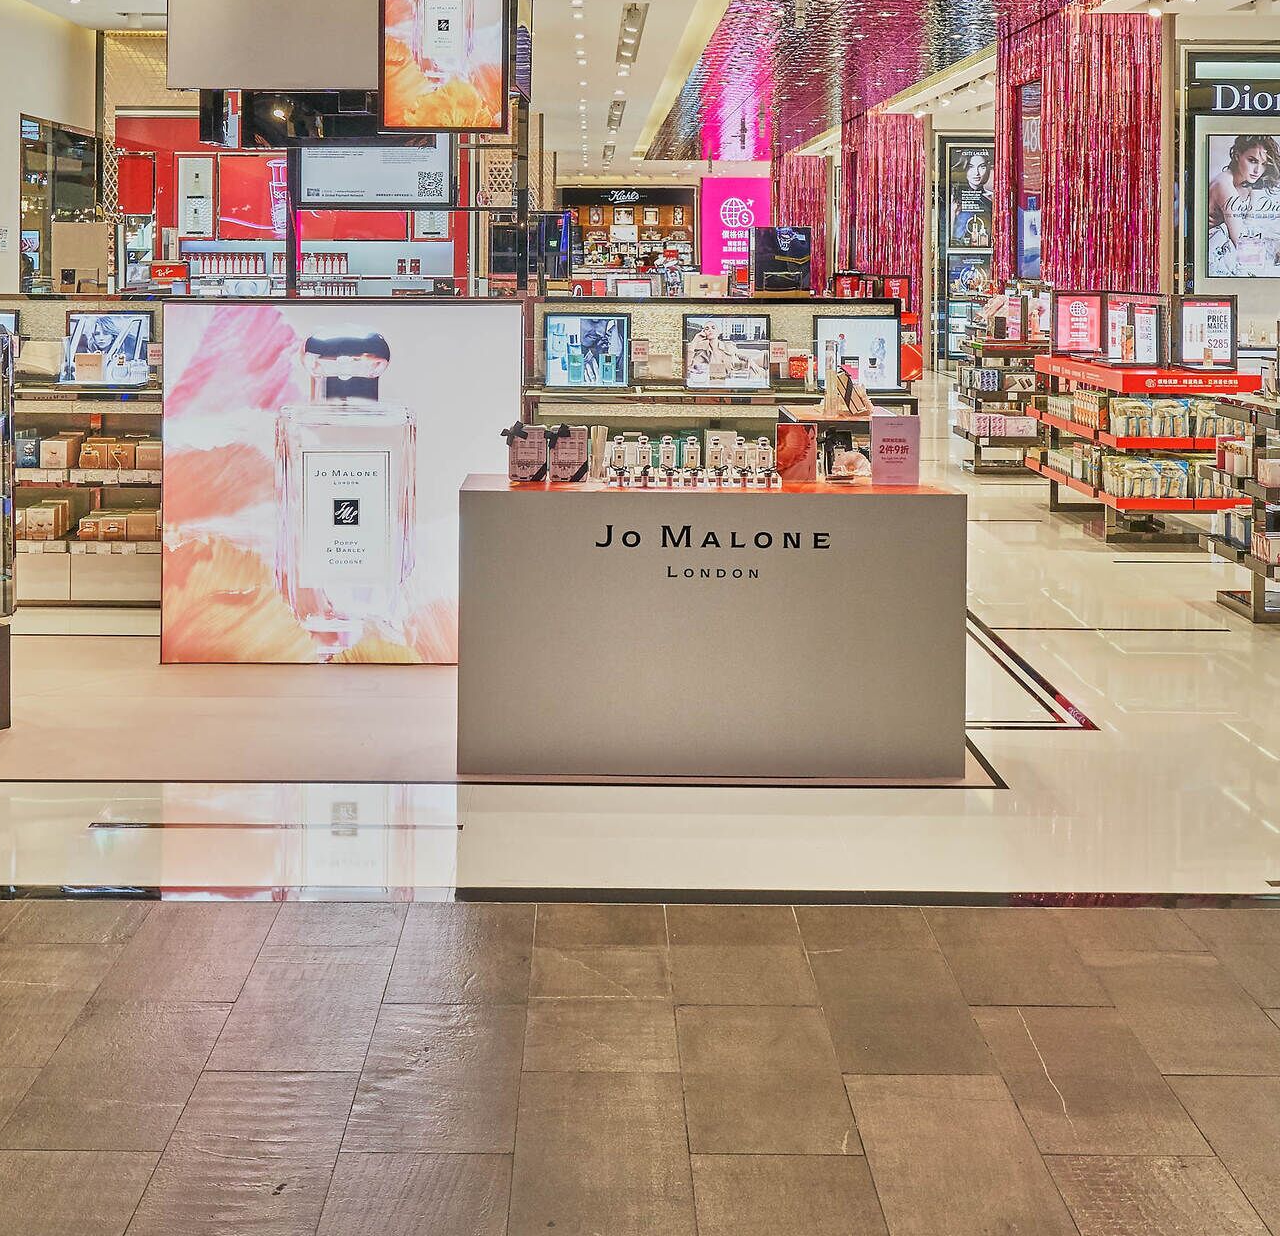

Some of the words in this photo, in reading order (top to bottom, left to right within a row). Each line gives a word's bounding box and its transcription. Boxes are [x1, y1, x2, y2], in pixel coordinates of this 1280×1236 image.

[1207, 314, 1228, 323] PRICE
[1207, 338, 1229, 349] $285
[331, 469, 379, 477] MALONE
[595, 524, 642, 549] JO
[661, 525, 832, 549] MALONE
[667, 565, 759, 578] LONDON
